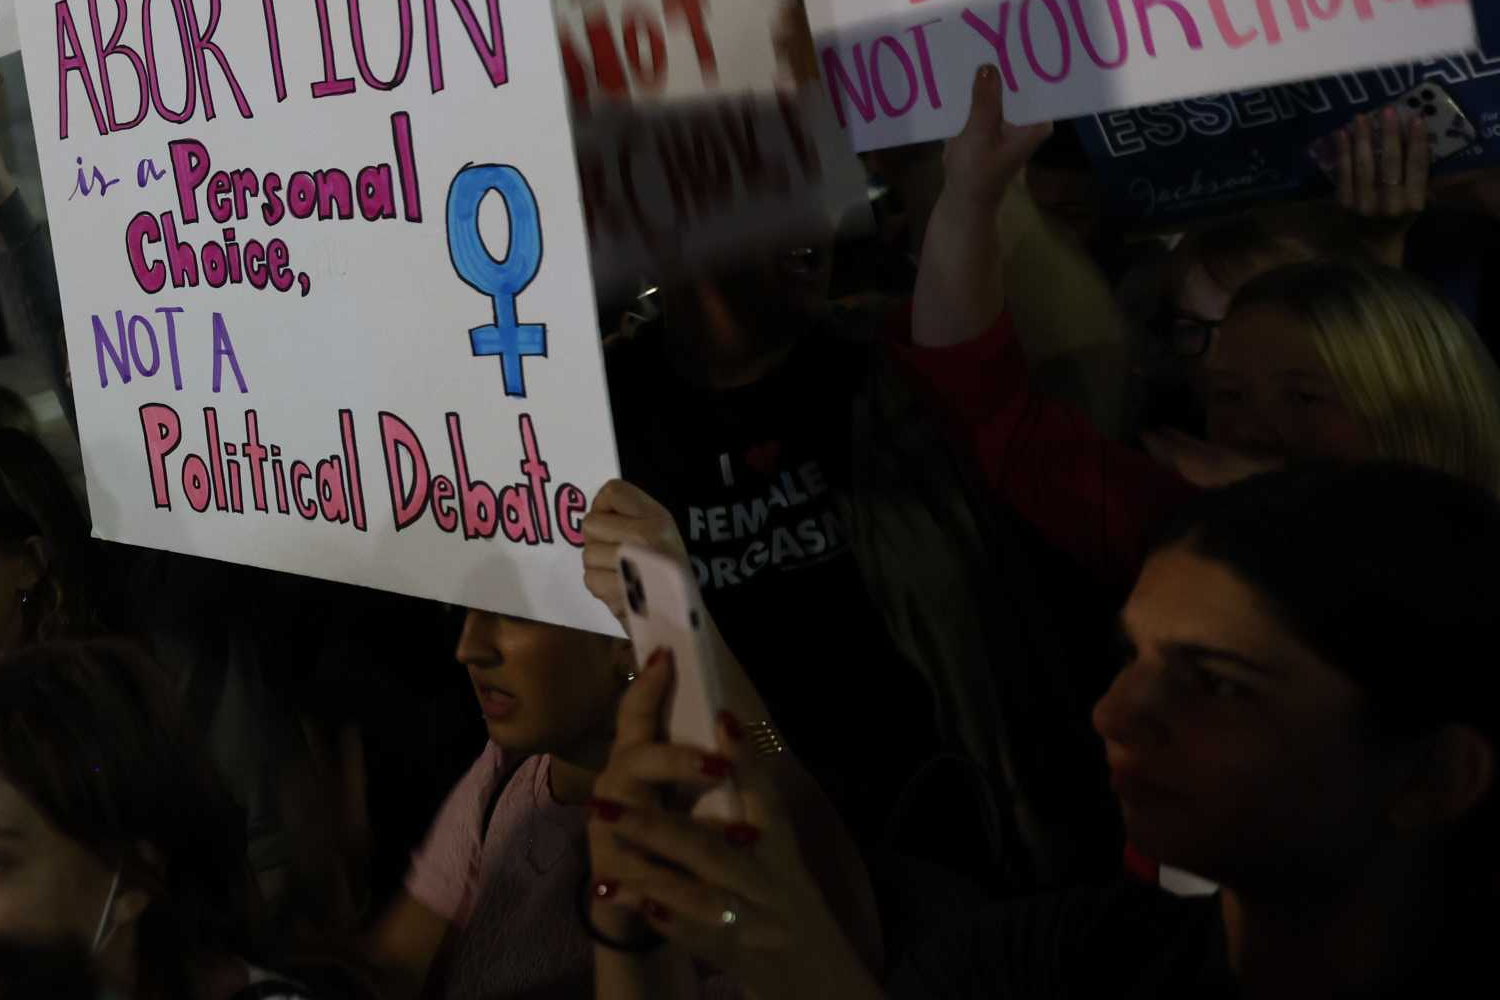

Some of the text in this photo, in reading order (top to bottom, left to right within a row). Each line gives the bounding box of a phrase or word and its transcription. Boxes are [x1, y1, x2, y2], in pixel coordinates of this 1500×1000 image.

[820, 17, 943, 128] NOT
[1097, 46, 1500, 158] ESSEN
[68, 111, 422, 226] is a Personal
[125, 210, 311, 296] Choice,
[91, 306, 248, 394] NOT A
[139, 402, 587, 546] Political Debate
[688, 458, 828, 544] FEMALE
[719, 451, 735, 489] I
